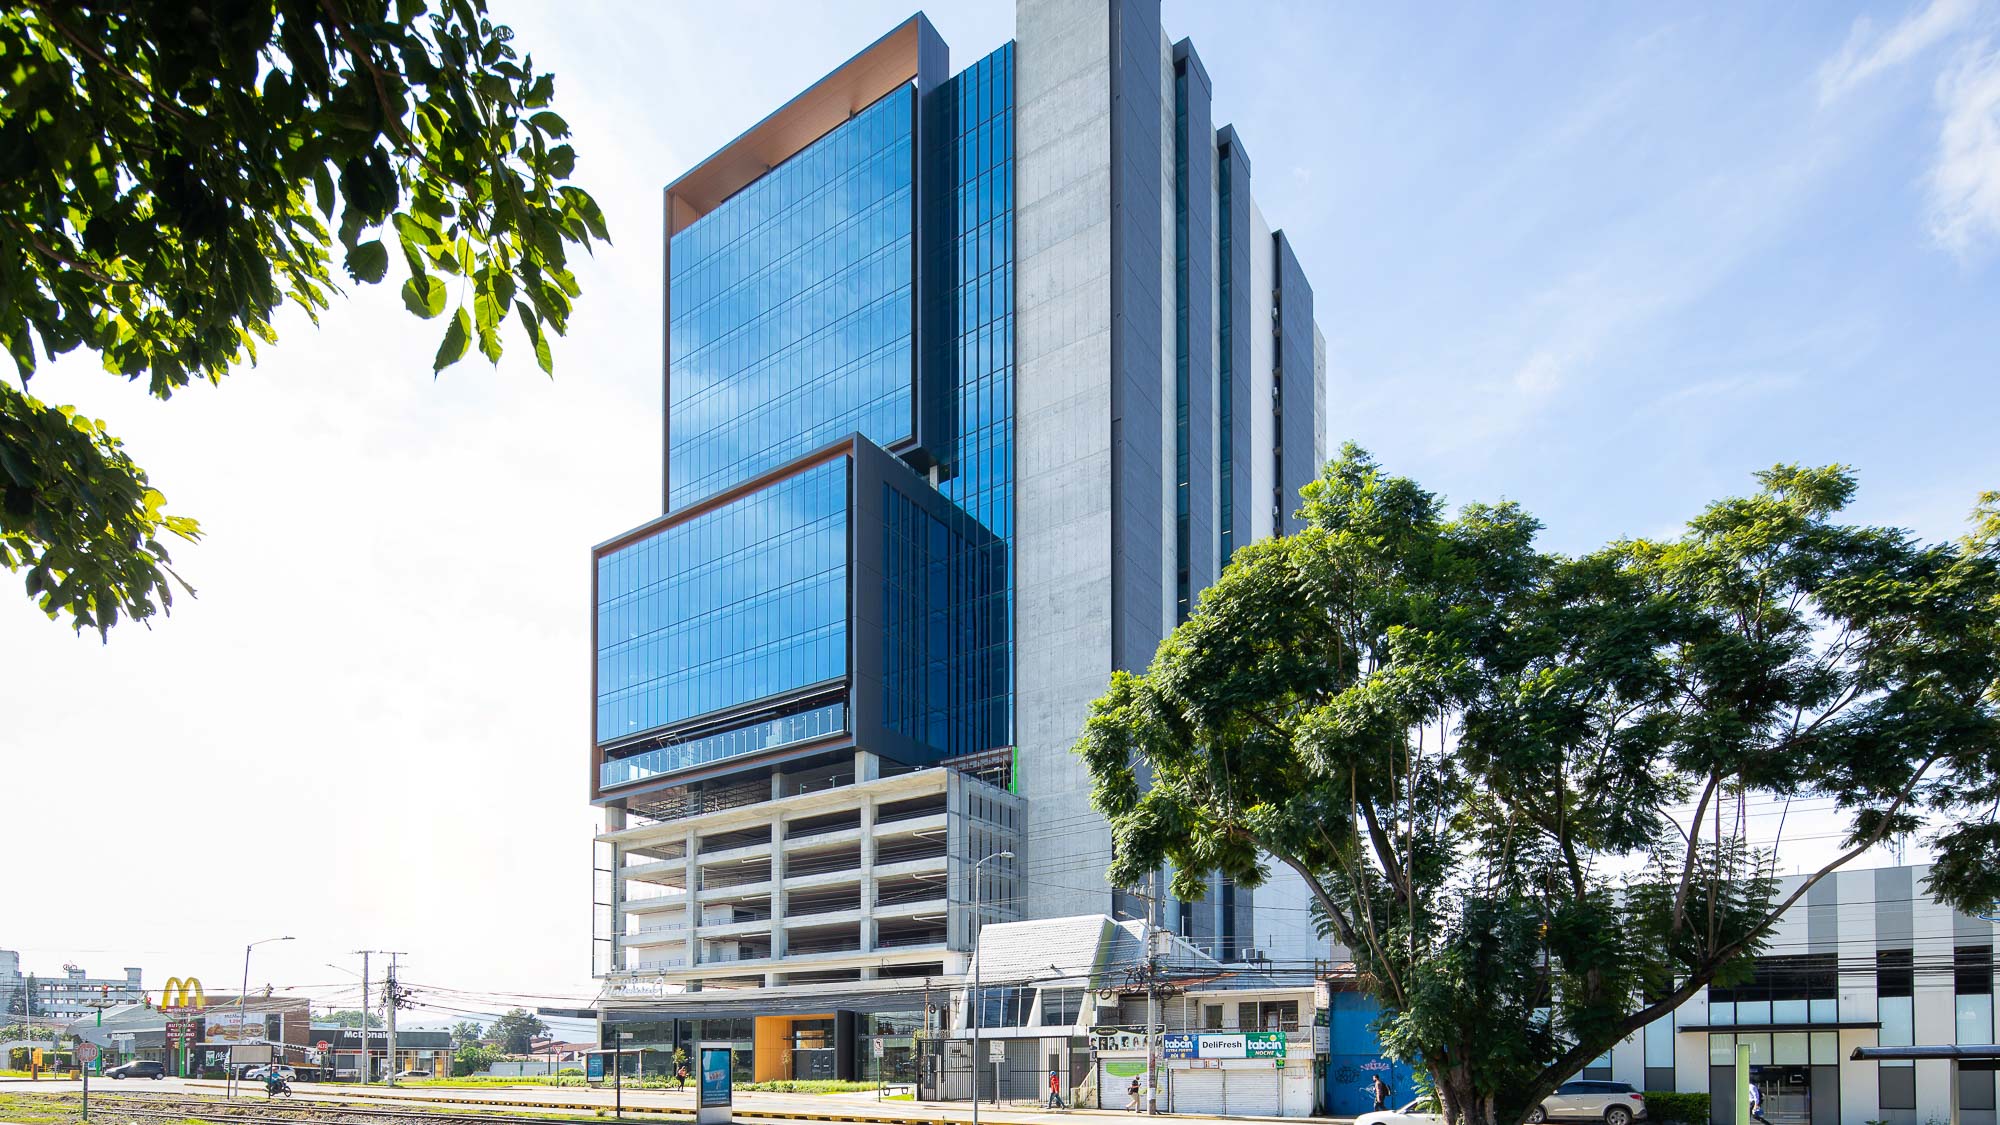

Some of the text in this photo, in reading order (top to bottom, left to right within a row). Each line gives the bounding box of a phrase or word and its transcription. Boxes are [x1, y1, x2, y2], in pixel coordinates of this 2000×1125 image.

[344, 1031, 398, 1039] McDonalds
[1165, 1039, 1193, 1049] tabcin
[1202, 1041, 1242, 1049] DeliFresh
[1247, 1039, 1282, 1050] tabcin
